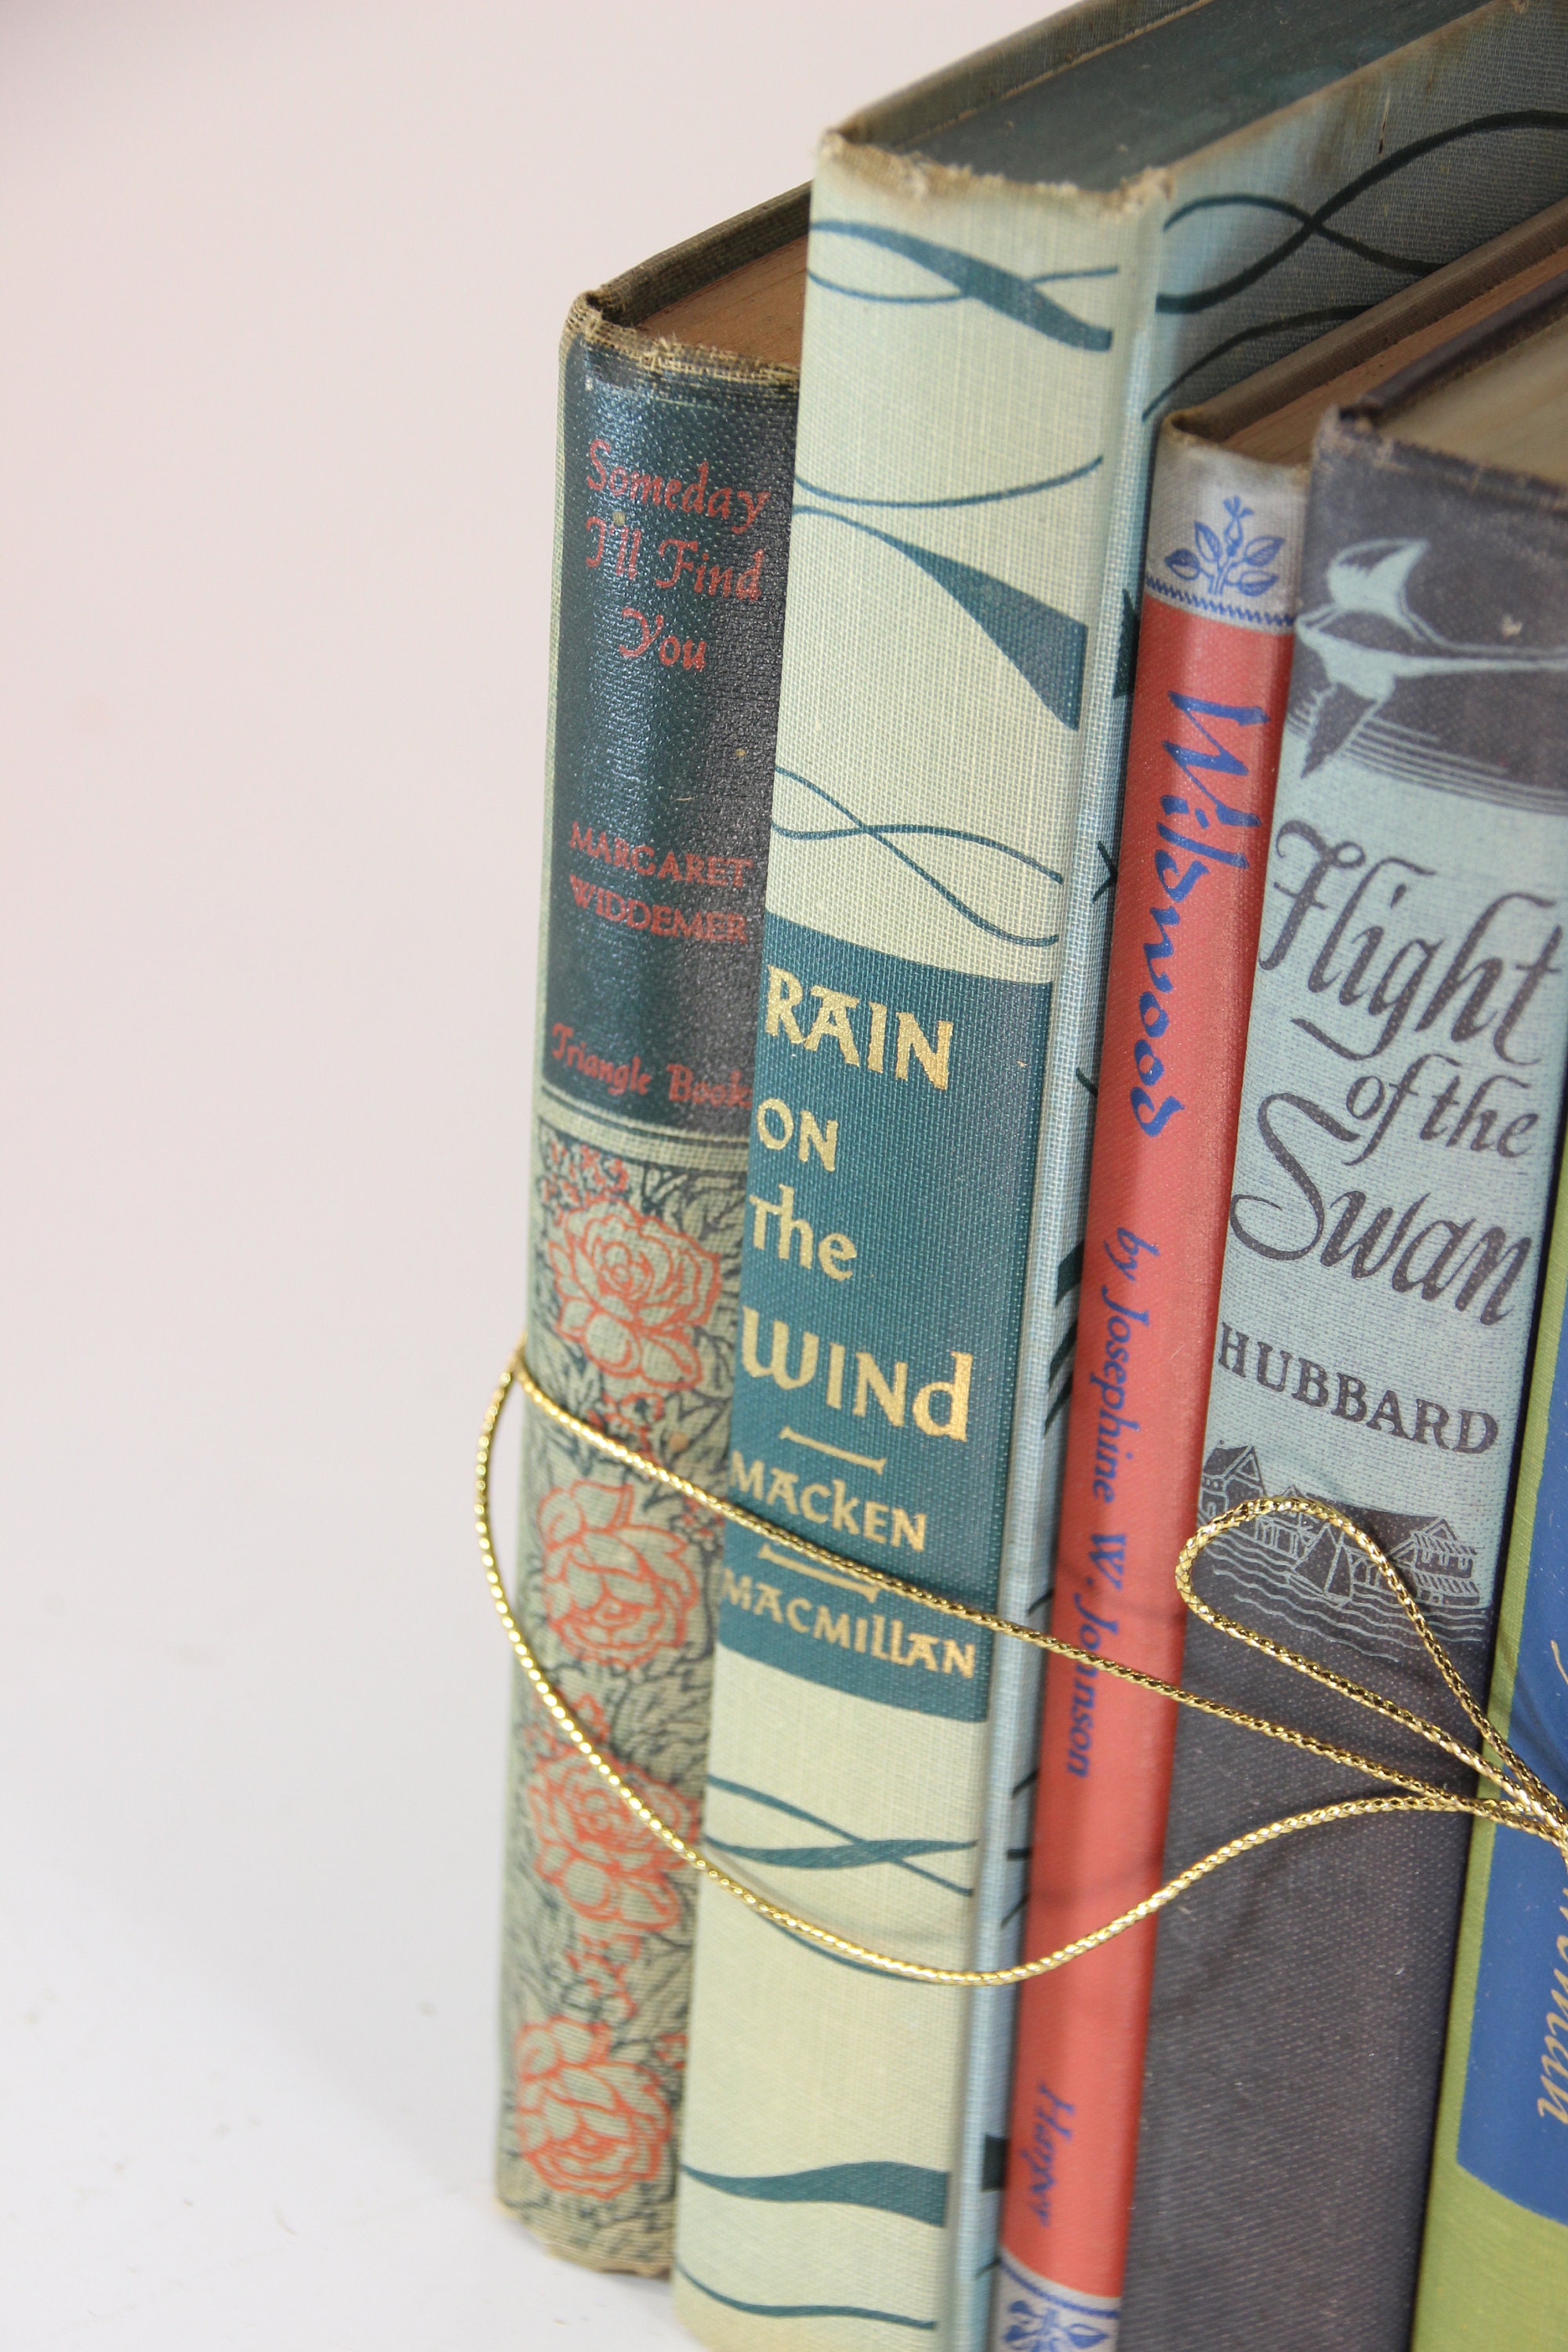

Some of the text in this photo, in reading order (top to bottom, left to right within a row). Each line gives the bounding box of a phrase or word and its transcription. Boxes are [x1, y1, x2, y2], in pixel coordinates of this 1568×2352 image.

[587, 438, 771, 535] Someday
[655, 538, 764, 601] Find
[618, 606, 707, 672] You
[569, 821, 754, 889] MARGARET
[569, 873, 749, 944] WIDDEMER
[1130, 690, 1271, 1138] Wildwood
[1258, 819, 1563, 1065] Flight
[552, 1022, 753, 1109] Triangle Book
[764, 964, 953, 1091] RAIN
[756, 1098, 839, 1173] ON
[1341, 1054, 1540, 1167] of the
[1103, 1225, 1160, 1281] by
[1229, 1092, 1532, 1326] Swan
[1089, 1284, 1150, 1504] Josephine
[1218, 1321, 1499, 1454] HUBBARD
[1087, 1533, 1127, 1588] W.
